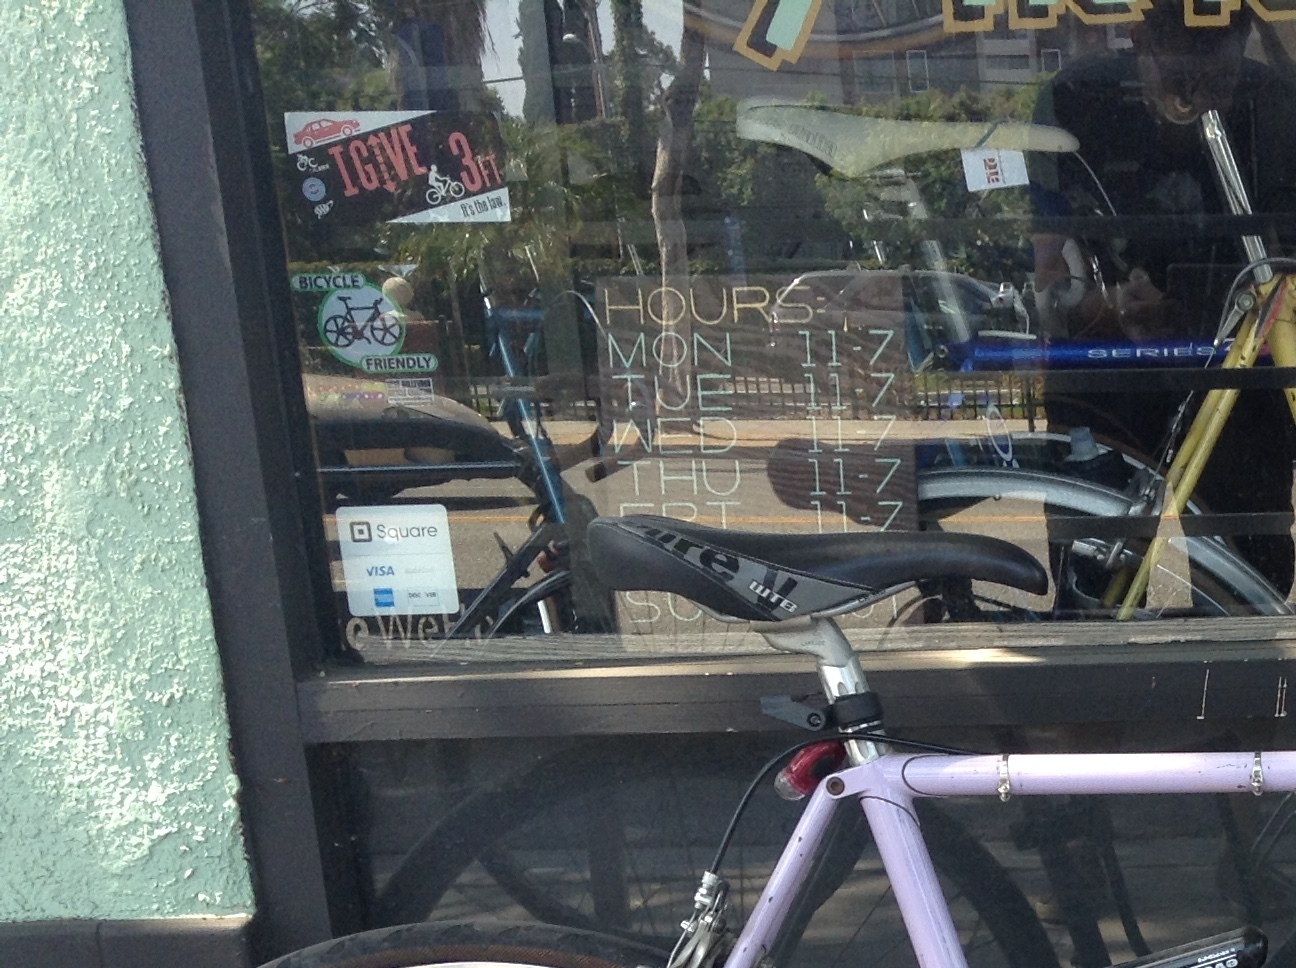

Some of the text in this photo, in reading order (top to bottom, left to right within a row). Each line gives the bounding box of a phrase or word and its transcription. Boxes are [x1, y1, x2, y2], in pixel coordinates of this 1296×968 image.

[474, 199, 488, 213] the
[298, 274, 361, 289] BICYCLE
[604, 286, 827, 326] HOURS:
[606, 329, 895, 369] MON 11-7
[1087, 345, 1216, 359] SERIES
[365, 356, 433, 371] FRIENDLY
[611, 372, 896, 412] TUE 11-7
[612, 414, 897, 455] WED 11-7
[618, 458, 902, 496] THU 11-7
[376, 523, 438, 543] Square
[366, 565, 395, 577] VISA
[748, 579, 798, 613] WTB
